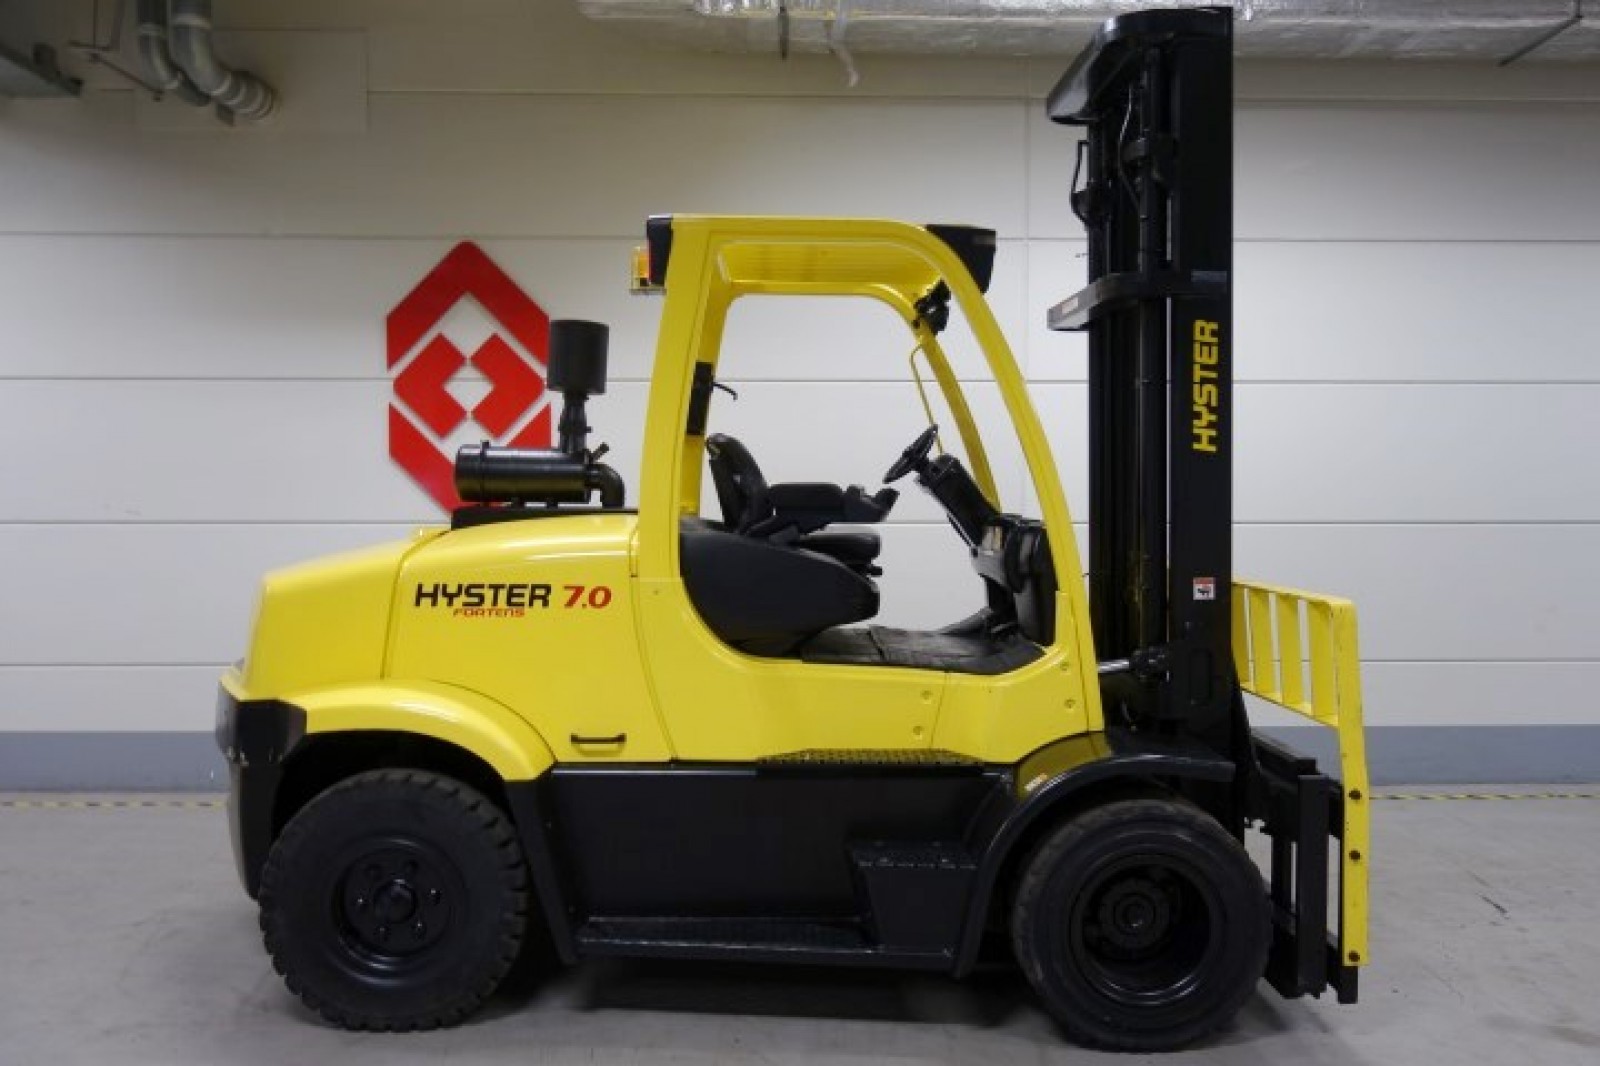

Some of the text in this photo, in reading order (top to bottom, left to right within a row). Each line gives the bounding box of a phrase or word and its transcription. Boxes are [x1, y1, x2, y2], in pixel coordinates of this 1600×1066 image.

[1192, 319, 1219, 453] HYSTER
[414, 582, 612, 609] HYSTER 7.0
[453, 608, 525, 618] FORTENS
